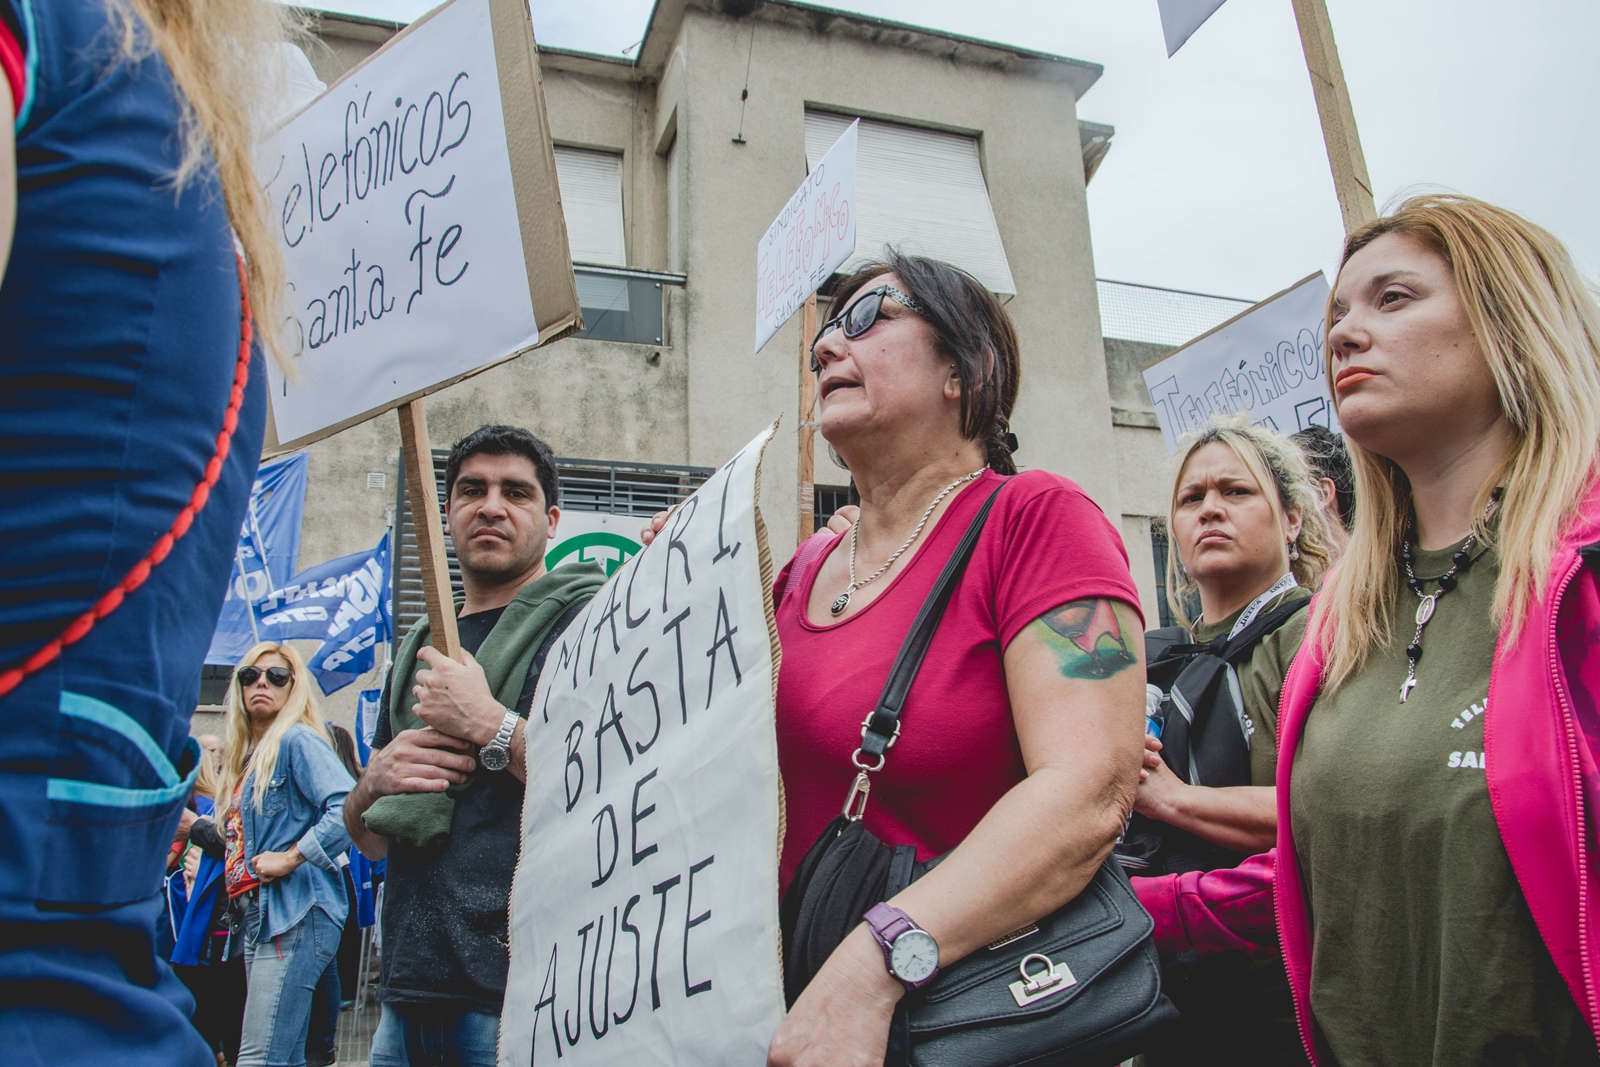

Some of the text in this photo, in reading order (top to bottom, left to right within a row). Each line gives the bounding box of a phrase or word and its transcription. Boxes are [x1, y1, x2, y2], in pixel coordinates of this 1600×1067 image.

[773, 263, 827, 329] SANTA FE
[564, 586, 742, 813] BASTA
[591, 767, 659, 888] DE
[530, 854, 715, 1067] AJUSTE
